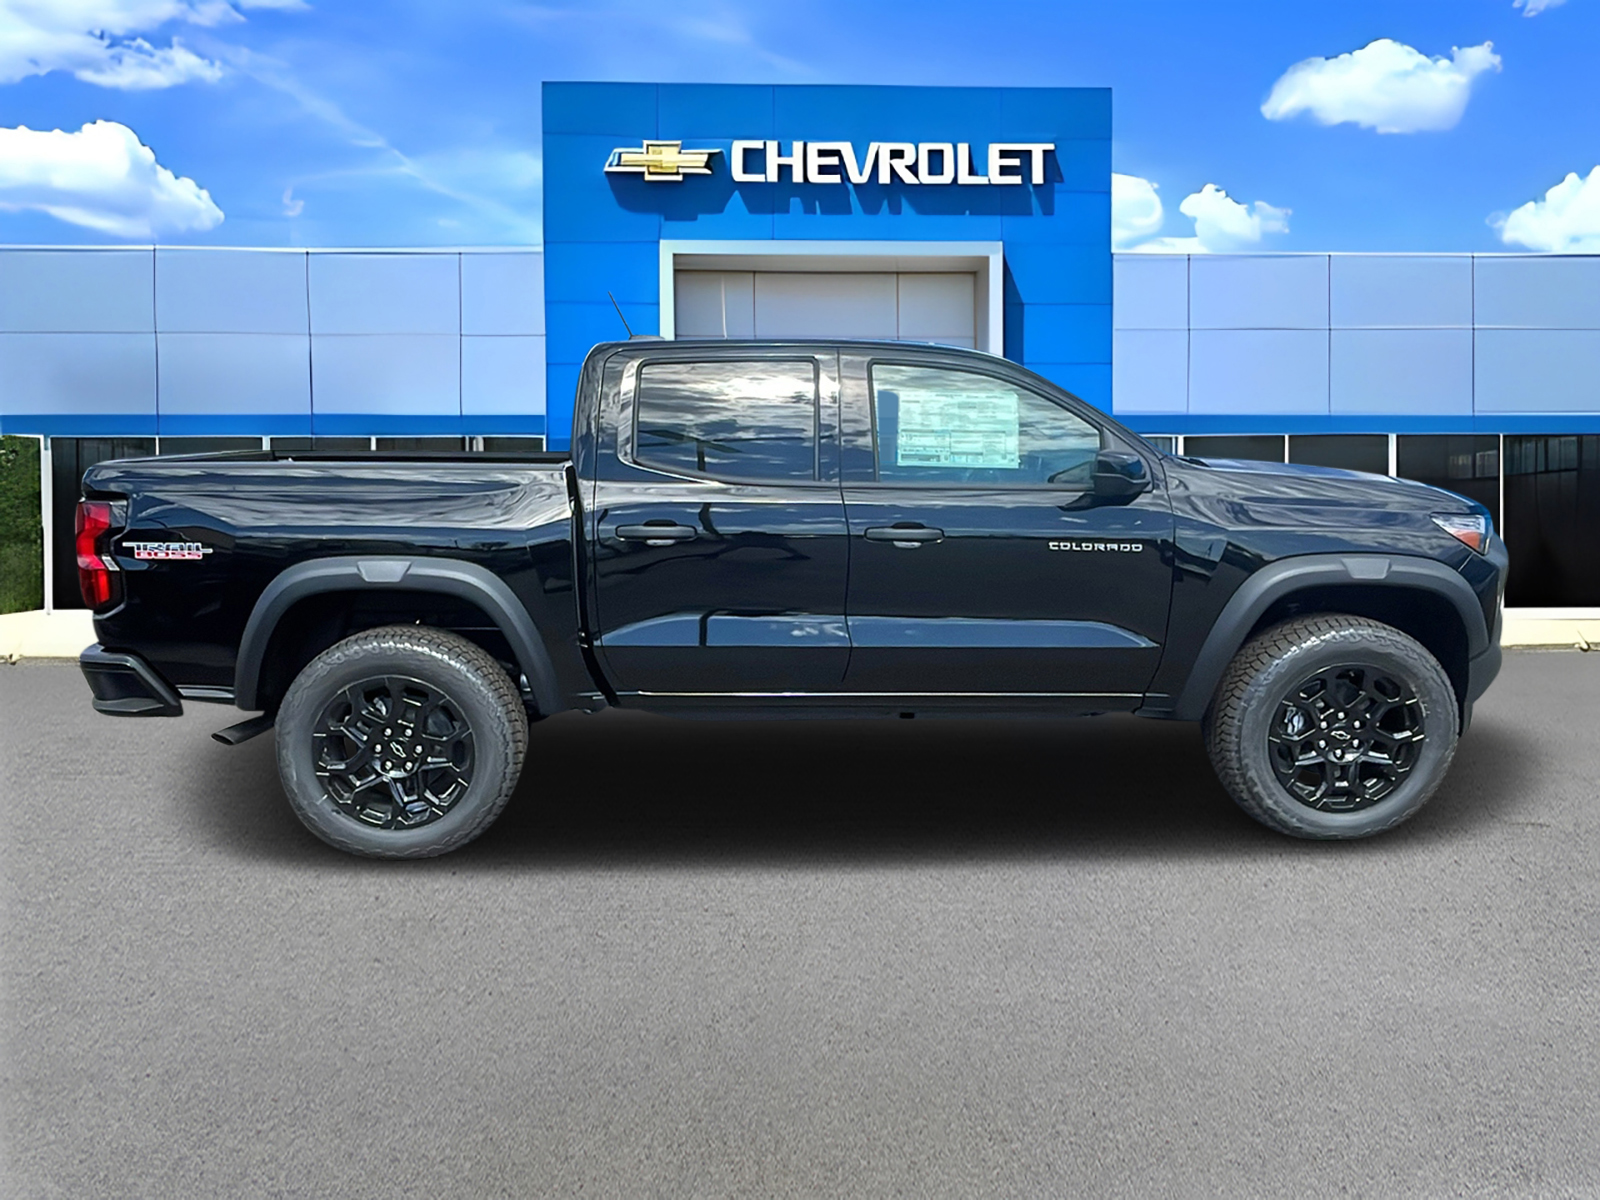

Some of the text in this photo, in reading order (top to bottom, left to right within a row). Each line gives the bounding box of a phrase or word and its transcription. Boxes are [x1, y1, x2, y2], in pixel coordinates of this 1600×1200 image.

[731, 140, 1055, 185] CHEVROLET
[122, 542, 213, 553] TRAIL
[1048, 542, 1143, 552] COLORADO
[134, 551, 203, 559] BOSS
